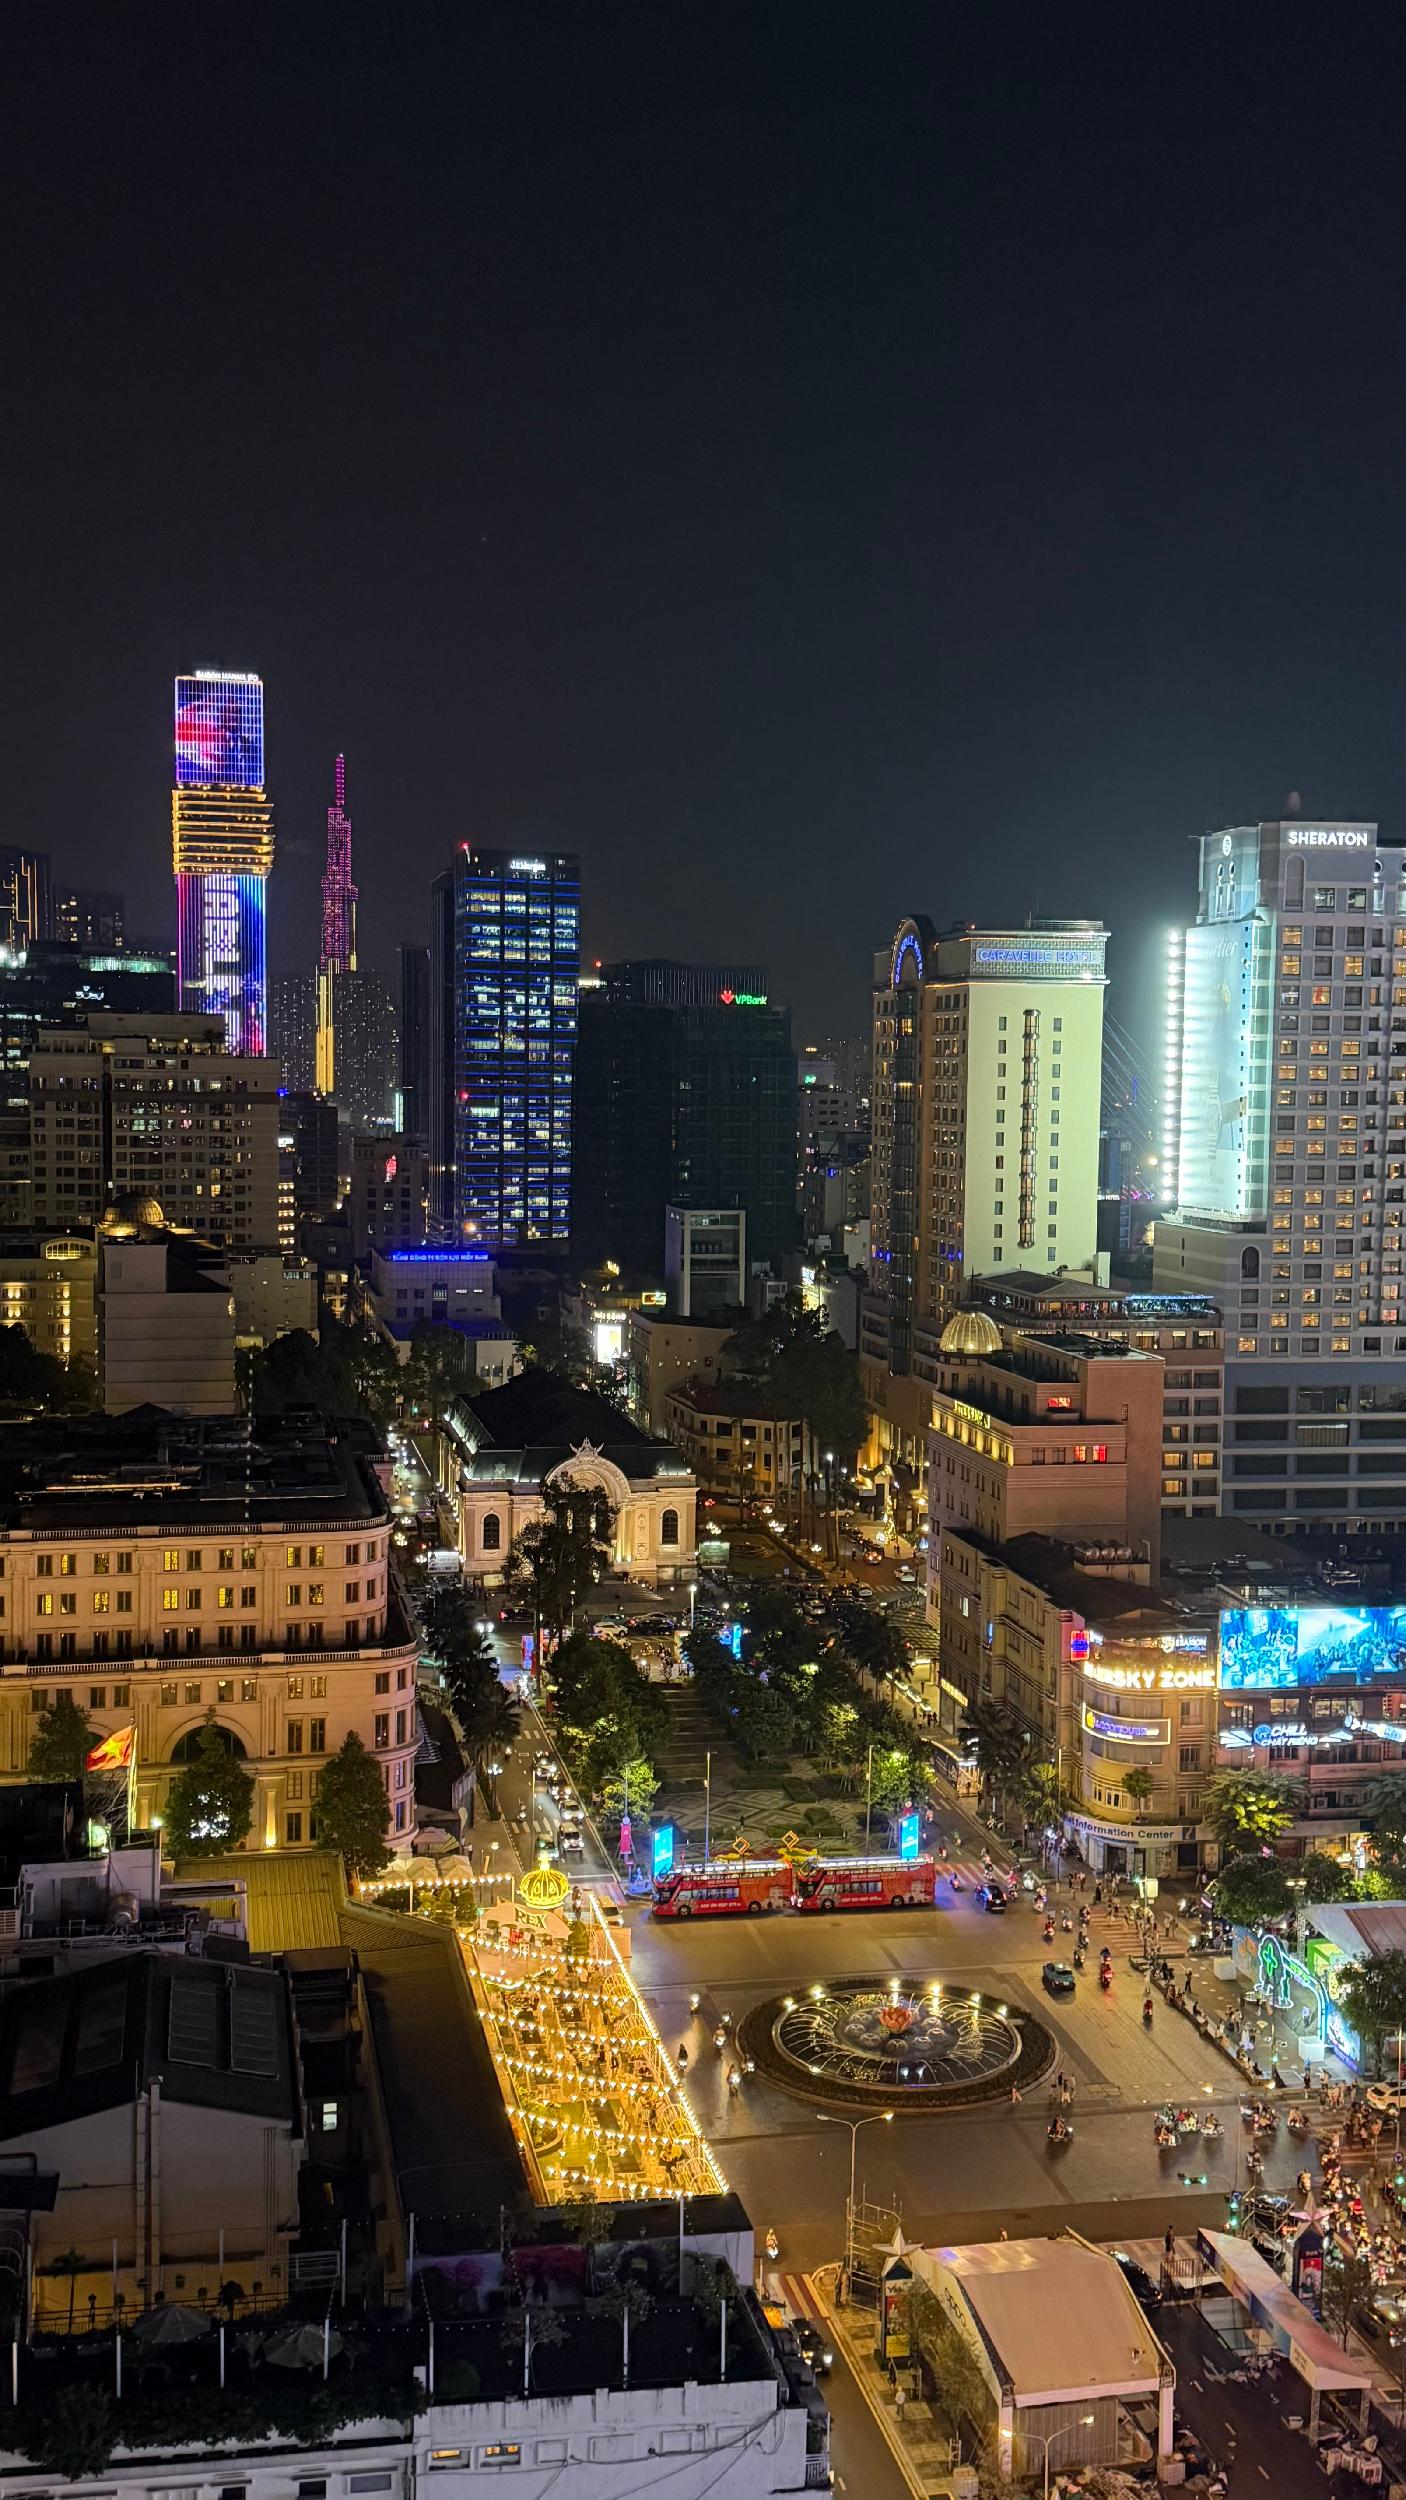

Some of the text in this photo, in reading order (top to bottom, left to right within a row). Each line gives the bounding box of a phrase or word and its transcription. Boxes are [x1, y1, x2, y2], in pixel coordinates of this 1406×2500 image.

[1288, 831, 1368, 847] SHERATON
[980, 950, 1053, 962] CARAVELLE
[735, 994, 767, 1005] VPBank
[1160, 1670, 1215, 1688] ZONE
[1271, 1724, 1307, 1737] CHILL
[1075, 1818, 1134, 1838] Information
[1138, 1830, 1174, 1839] Center
[515, 1907, 547, 1930] REX
